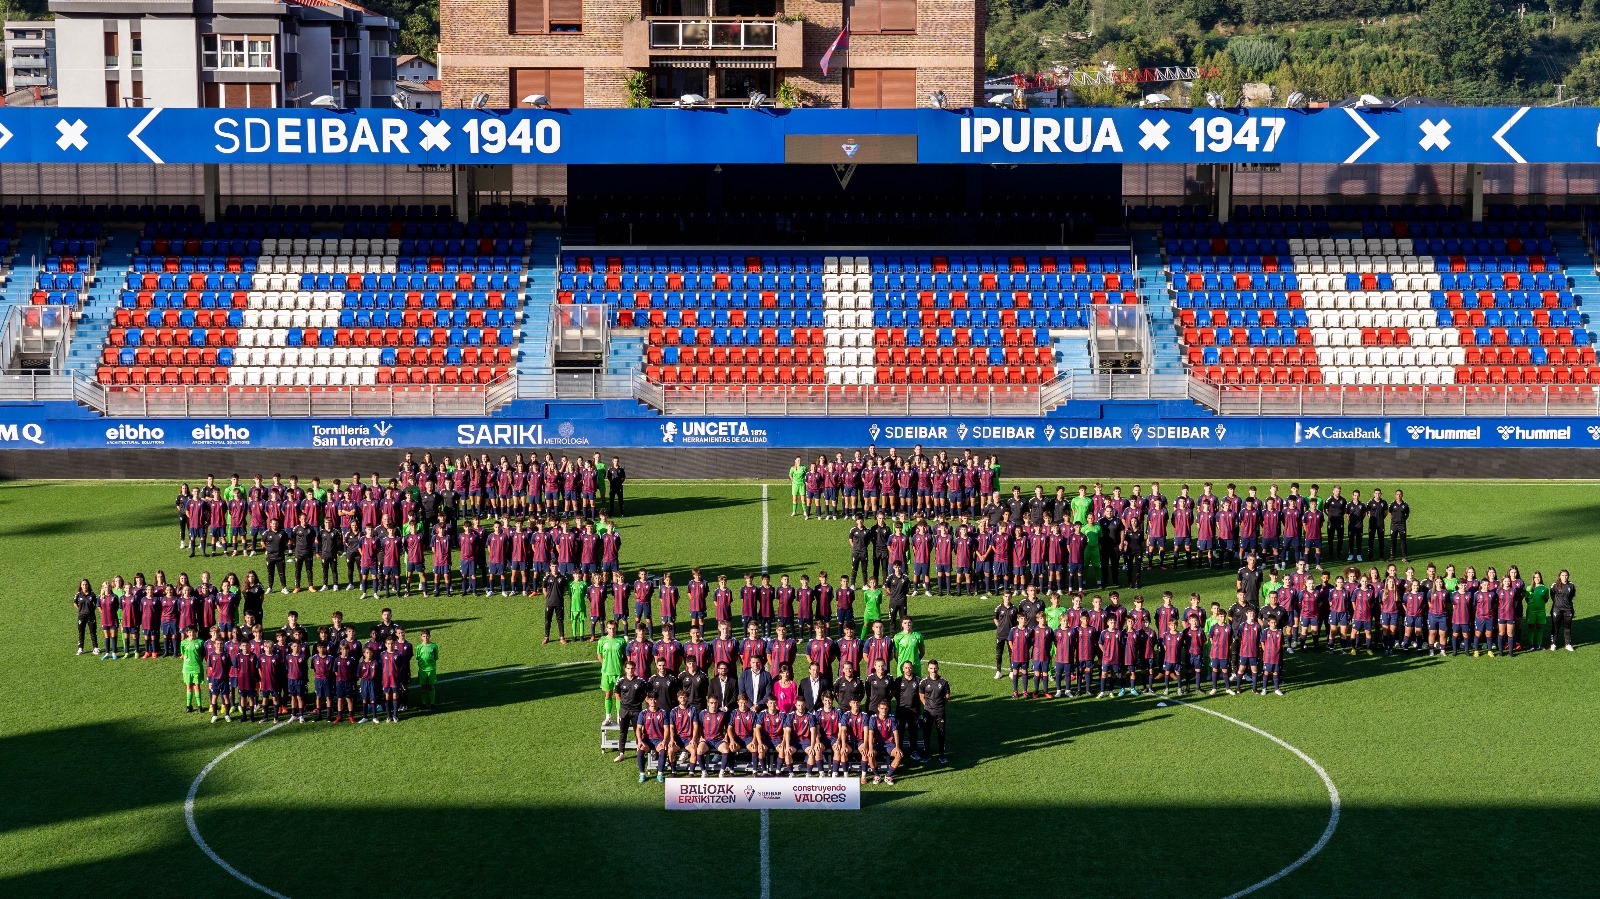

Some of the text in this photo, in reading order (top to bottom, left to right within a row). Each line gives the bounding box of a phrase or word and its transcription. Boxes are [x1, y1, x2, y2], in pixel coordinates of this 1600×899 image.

[213, 117, 561, 154] SDEIBAR 1940
[960, 117, 1287, 154] IPURUA 1947
[105, 423, 165, 440] eibho
[191, 423, 250, 440] eibho
[312, 424, 370, 435] Tornillería
[457, 424, 543, 445] SARIKI
[682, 421, 750, 436] UNCETA
[885, 426, 948, 439] SDEIBAR
[972, 426, 1035, 439] SDEIBAR
[1059, 426, 1123, 439] SDEIBAR
[1147, 426, 1211, 439] SDEIBAR
[1321, 426, 1382, 439] CaixaBank
[1425, 425, 1481, 440] hummel
[1515, 425, 1571, 440] hummel
[312, 435, 394, 447] San Lorenzo
[792, 784, 847, 793] construyendo
